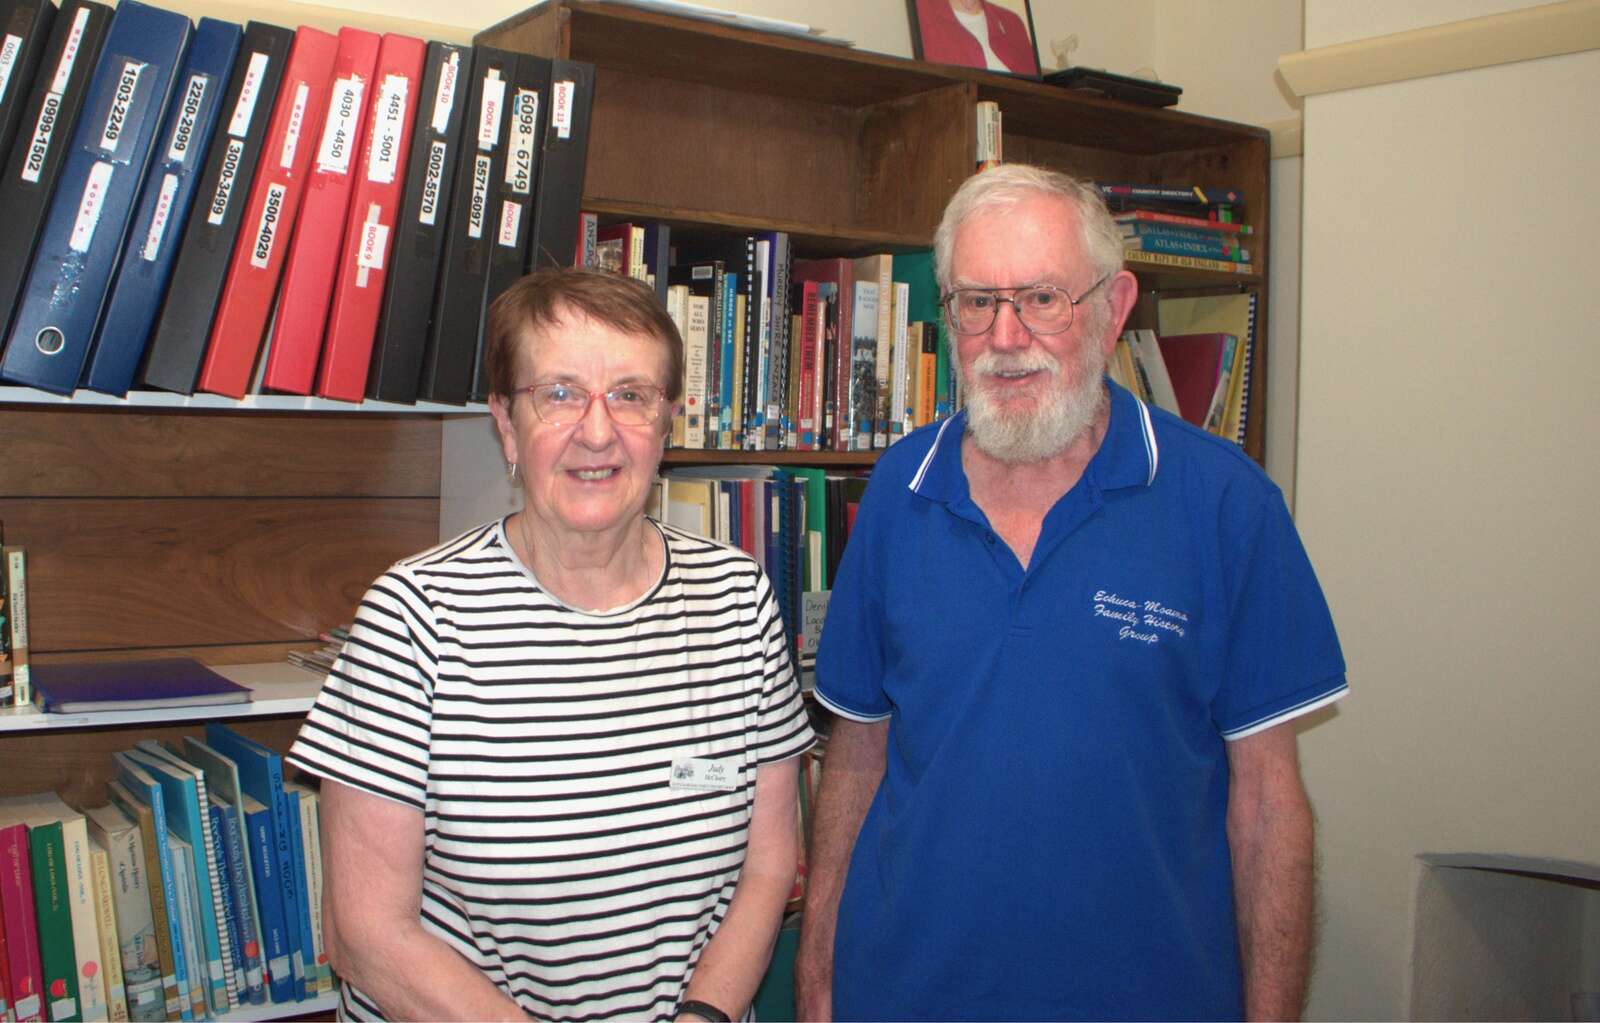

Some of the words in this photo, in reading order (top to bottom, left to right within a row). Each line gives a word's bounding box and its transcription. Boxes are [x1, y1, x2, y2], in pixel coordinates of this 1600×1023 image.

[67, 29, 81, 61] BOOK
[242, 72, 255, 103] BOOK
[444, 65, 456, 91] BOOK
[105, 67, 138, 141] 1503-2249
[386, 92, 401, 122] 4451
[440, 92, 450, 104] 10
[486, 100, 495, 126] BOOK
[557, 86, 566, 112] BOOK
[174, 80, 204, 152] 2250-2999
[290, 104, 302, 135] BOOK
[518, 94, 535, 135] 6098
[27, 98, 59, 173] 0999-1502
[379, 134, 394, 163] 5001
[484, 127, 491, 139] 11
[212, 143, 241, 215] 3000-3499
[422, 146, 443, 214] 5002-5570
[515, 149, 530, 191] 6749
[84, 183, 99, 216] BOOK
[470, 159, 488, 228] 5571-6097
[156, 194, 169, 226] BOOK
[256, 189, 283, 260] 3500-4029
[504, 203, 515, 229] BOOK
[366, 226, 376, 252] BOOK
[502, 230, 511, 241] 12
[364, 252, 371, 260] 9
[1094, 604, 1139, 626] Family
[1143, 614, 1185, 637] History
[1119, 626, 1159, 645] Group
